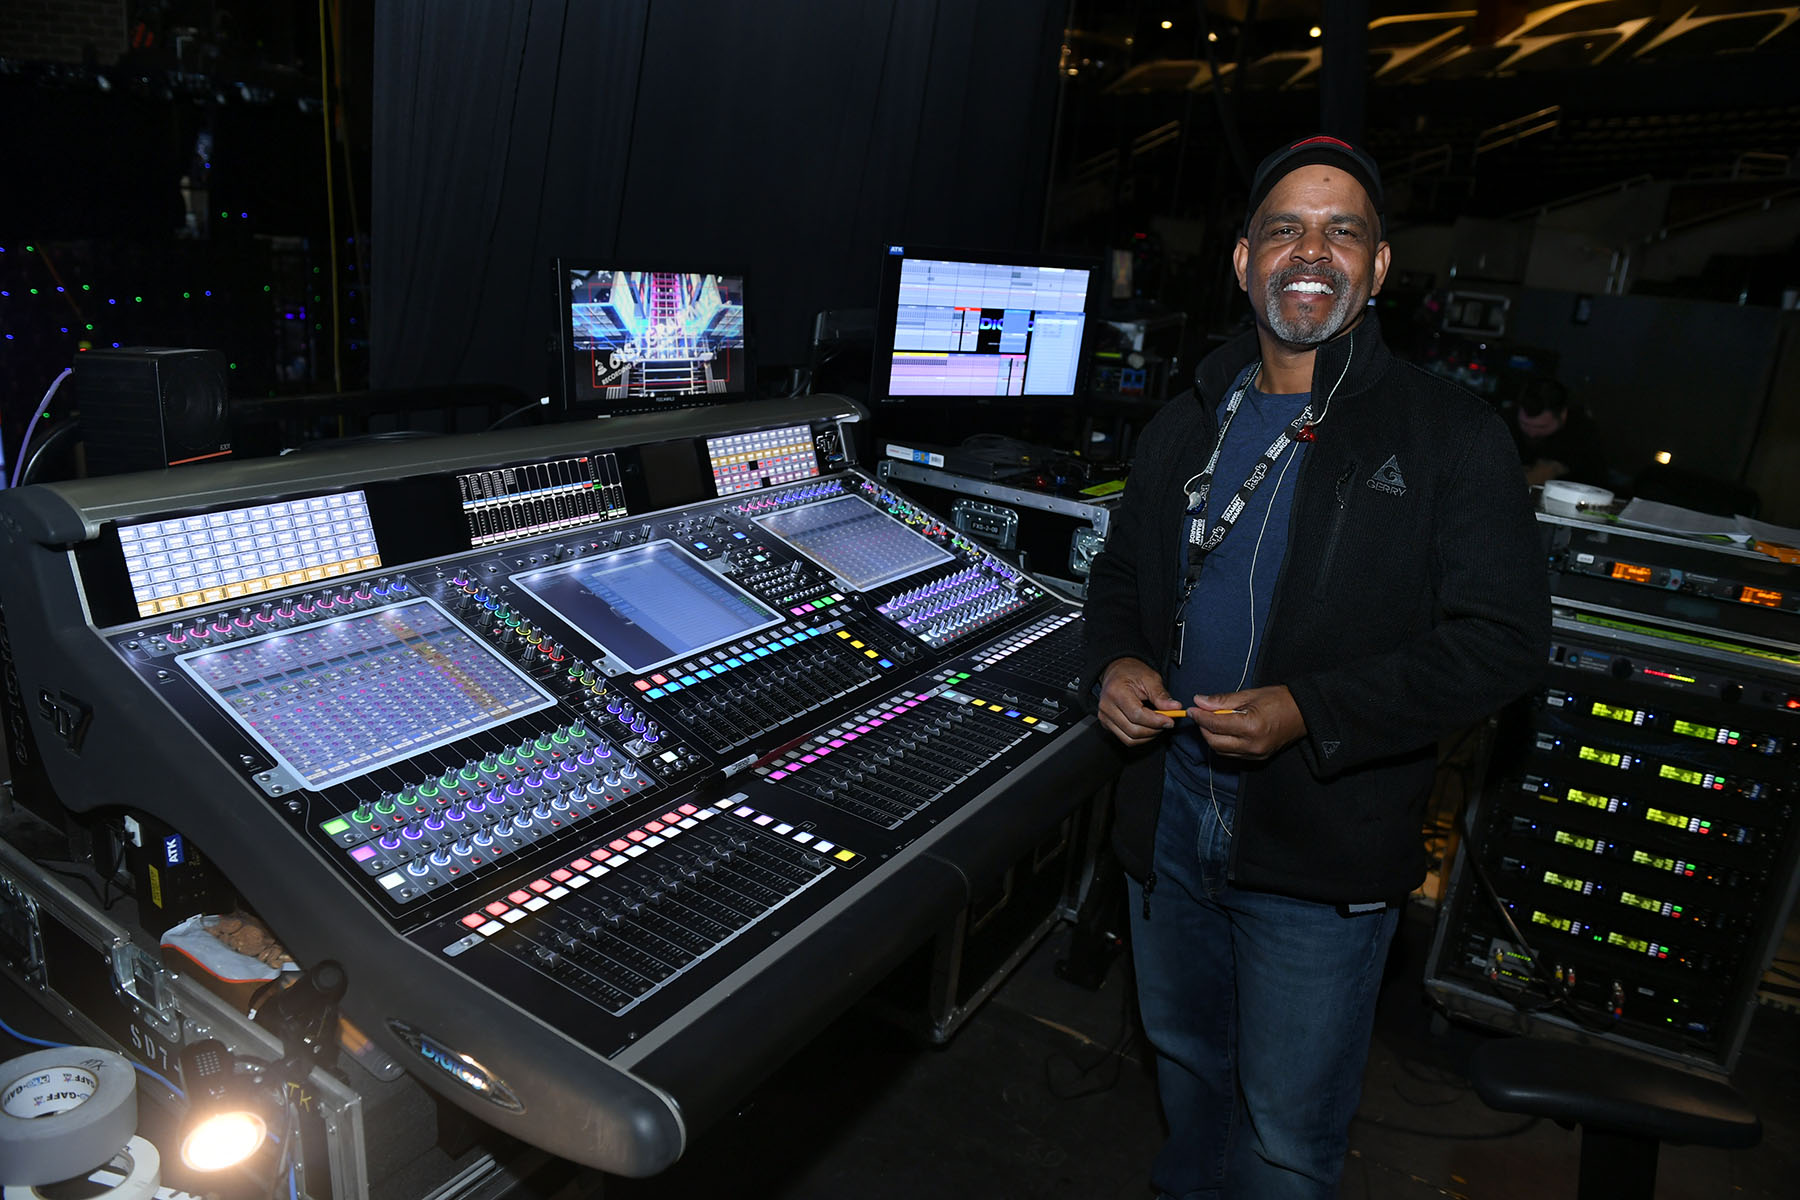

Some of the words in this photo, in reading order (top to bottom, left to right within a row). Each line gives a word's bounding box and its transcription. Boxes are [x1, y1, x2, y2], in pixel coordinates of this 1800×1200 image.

[1266, 434, 1287, 458] GRAMMY
[1366, 479, 1407, 497] GERRY
[1223, 496, 1242, 521] GRAMMY
[1229, 500, 1246, 525] AWARDS
[166, 838, 179, 863] ATK
